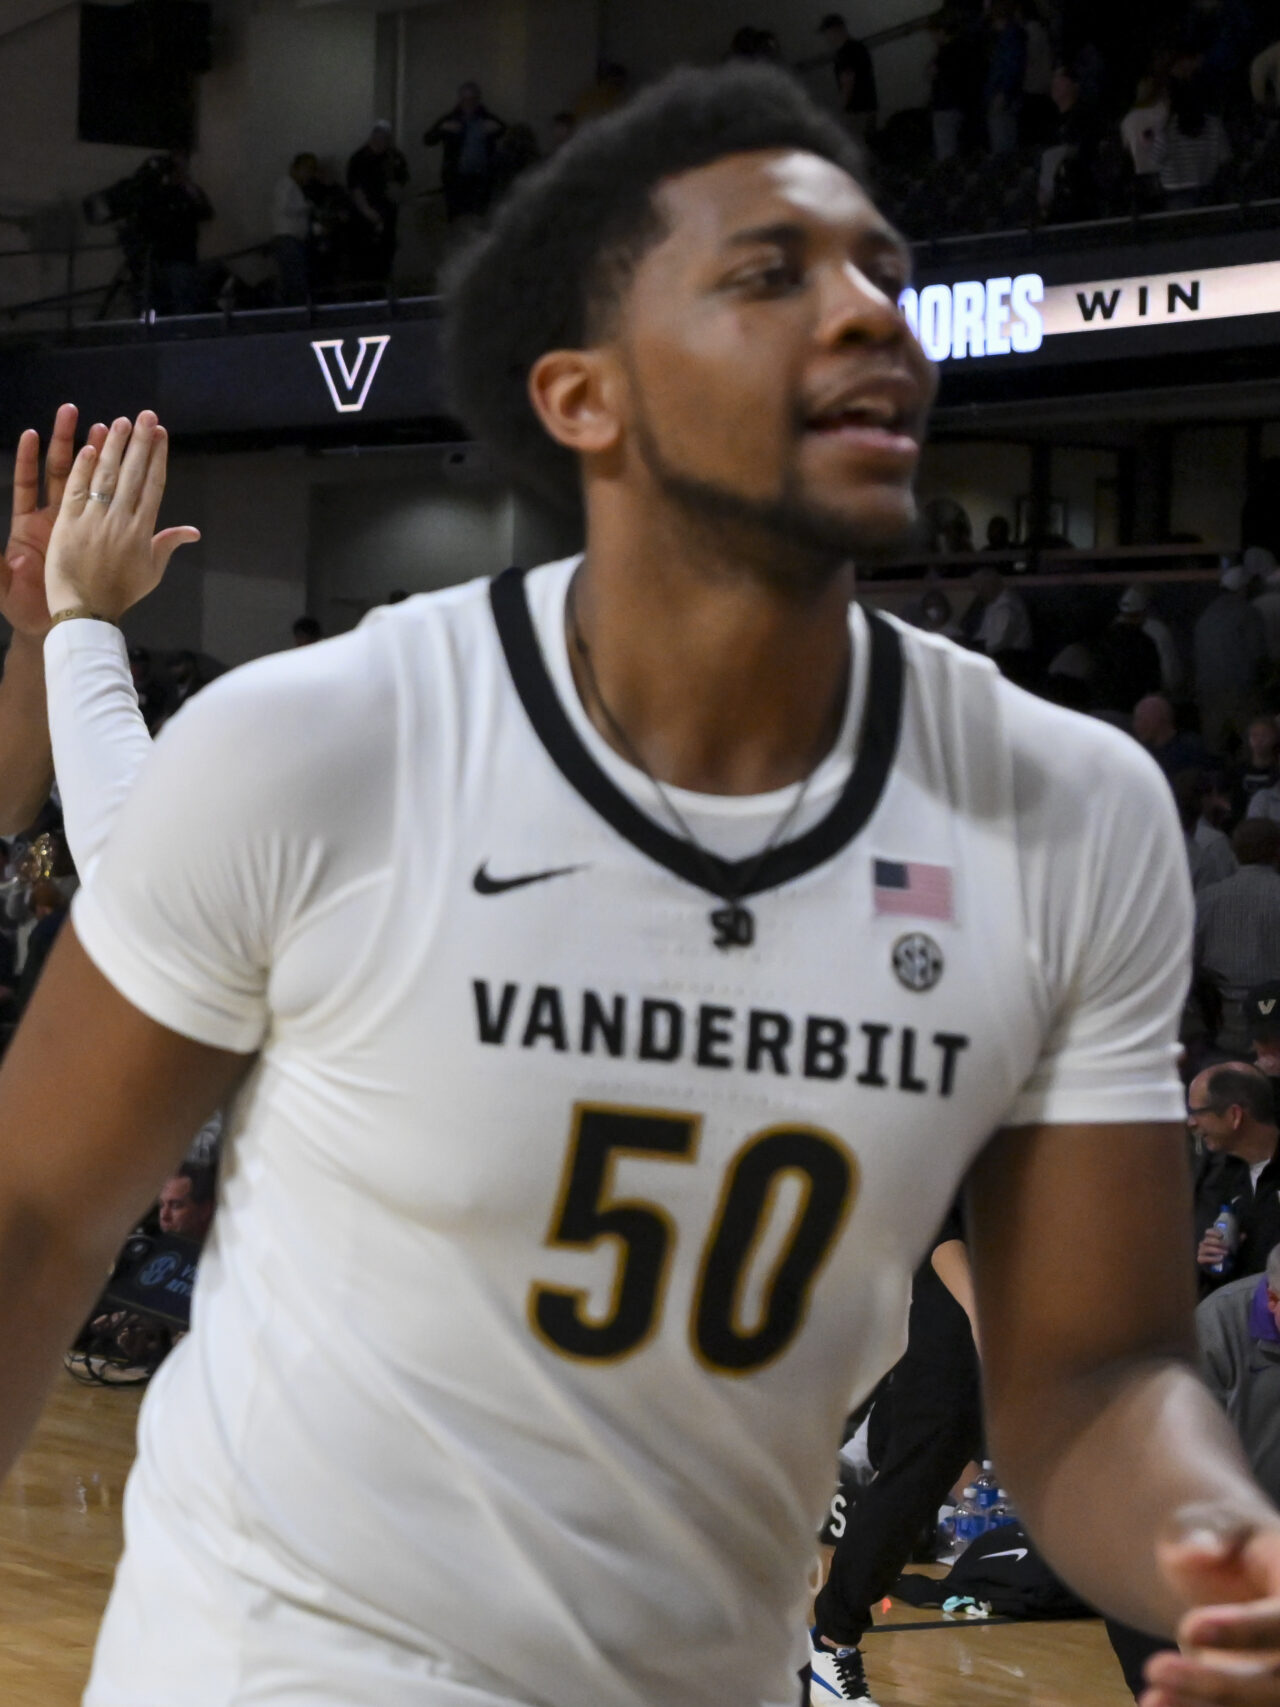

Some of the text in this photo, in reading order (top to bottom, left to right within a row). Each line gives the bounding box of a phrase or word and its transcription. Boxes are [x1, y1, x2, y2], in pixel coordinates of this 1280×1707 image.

[1076, 281, 1200, 322] WIN
[311, 335, 390, 412] V
[472, 978, 970, 1099] VANDERBILT
[526, 1099, 862, 1378] 50
[829, 1493, 848, 1538] S
